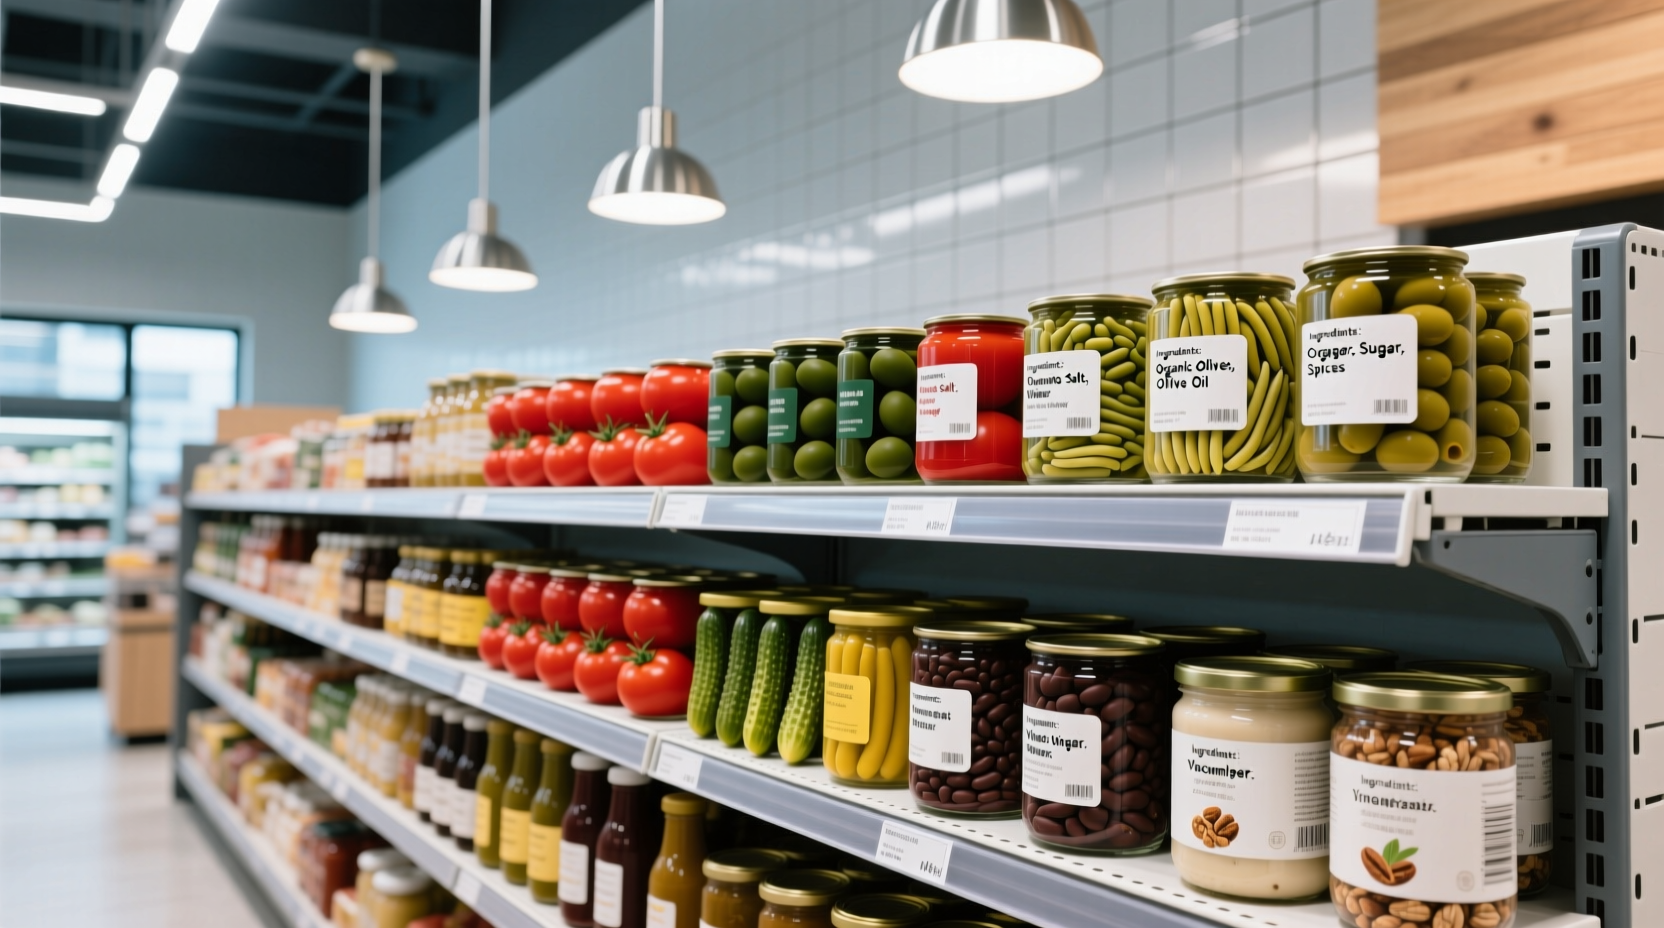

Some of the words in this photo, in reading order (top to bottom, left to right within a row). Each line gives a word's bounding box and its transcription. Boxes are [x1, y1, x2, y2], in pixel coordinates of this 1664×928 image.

[1359, 341, 1405, 358] Sugar,
[1307, 363, 1346, 378] Spices
[1064, 371, 1089, 386] Salt,
[1156, 377, 1187, 390] Olive
[1191, 375, 1209, 388] Oil
